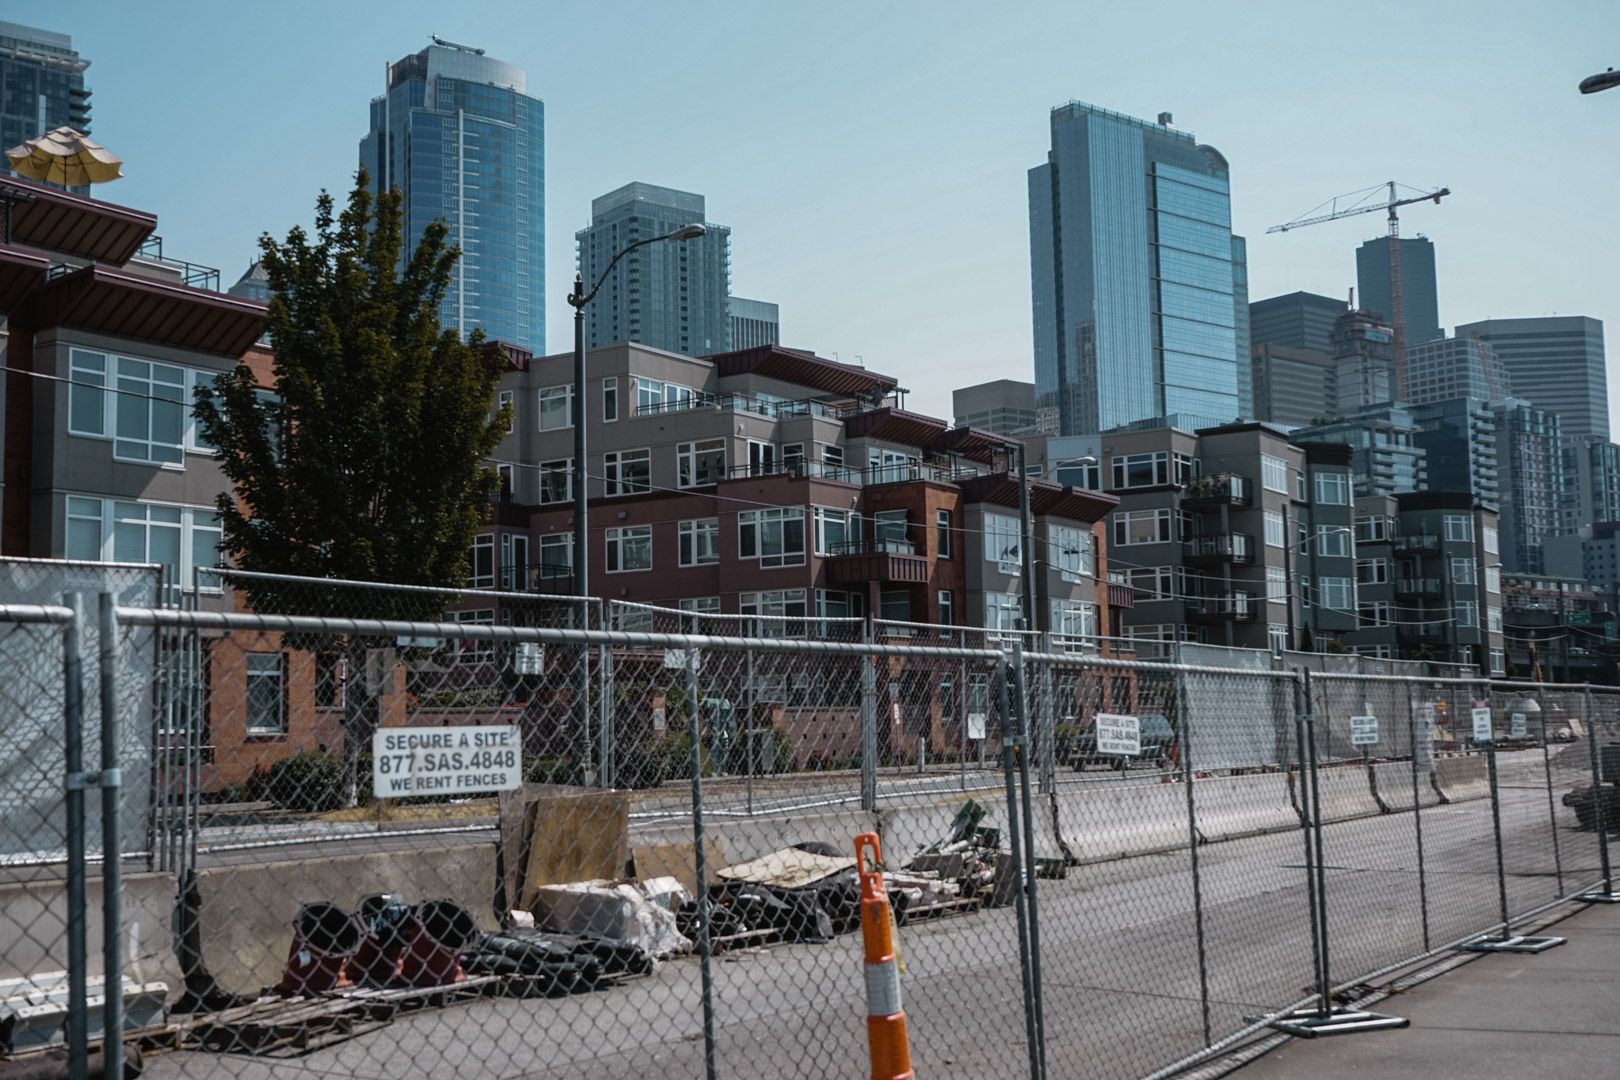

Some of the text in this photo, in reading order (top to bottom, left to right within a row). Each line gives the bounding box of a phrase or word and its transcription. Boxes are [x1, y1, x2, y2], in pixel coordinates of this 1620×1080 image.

[385, 732, 509, 750] SECURE A SITE
[379, 751, 515, 774] 877.SAS.4848
[390, 773, 507, 791] WE RENT FENCES
